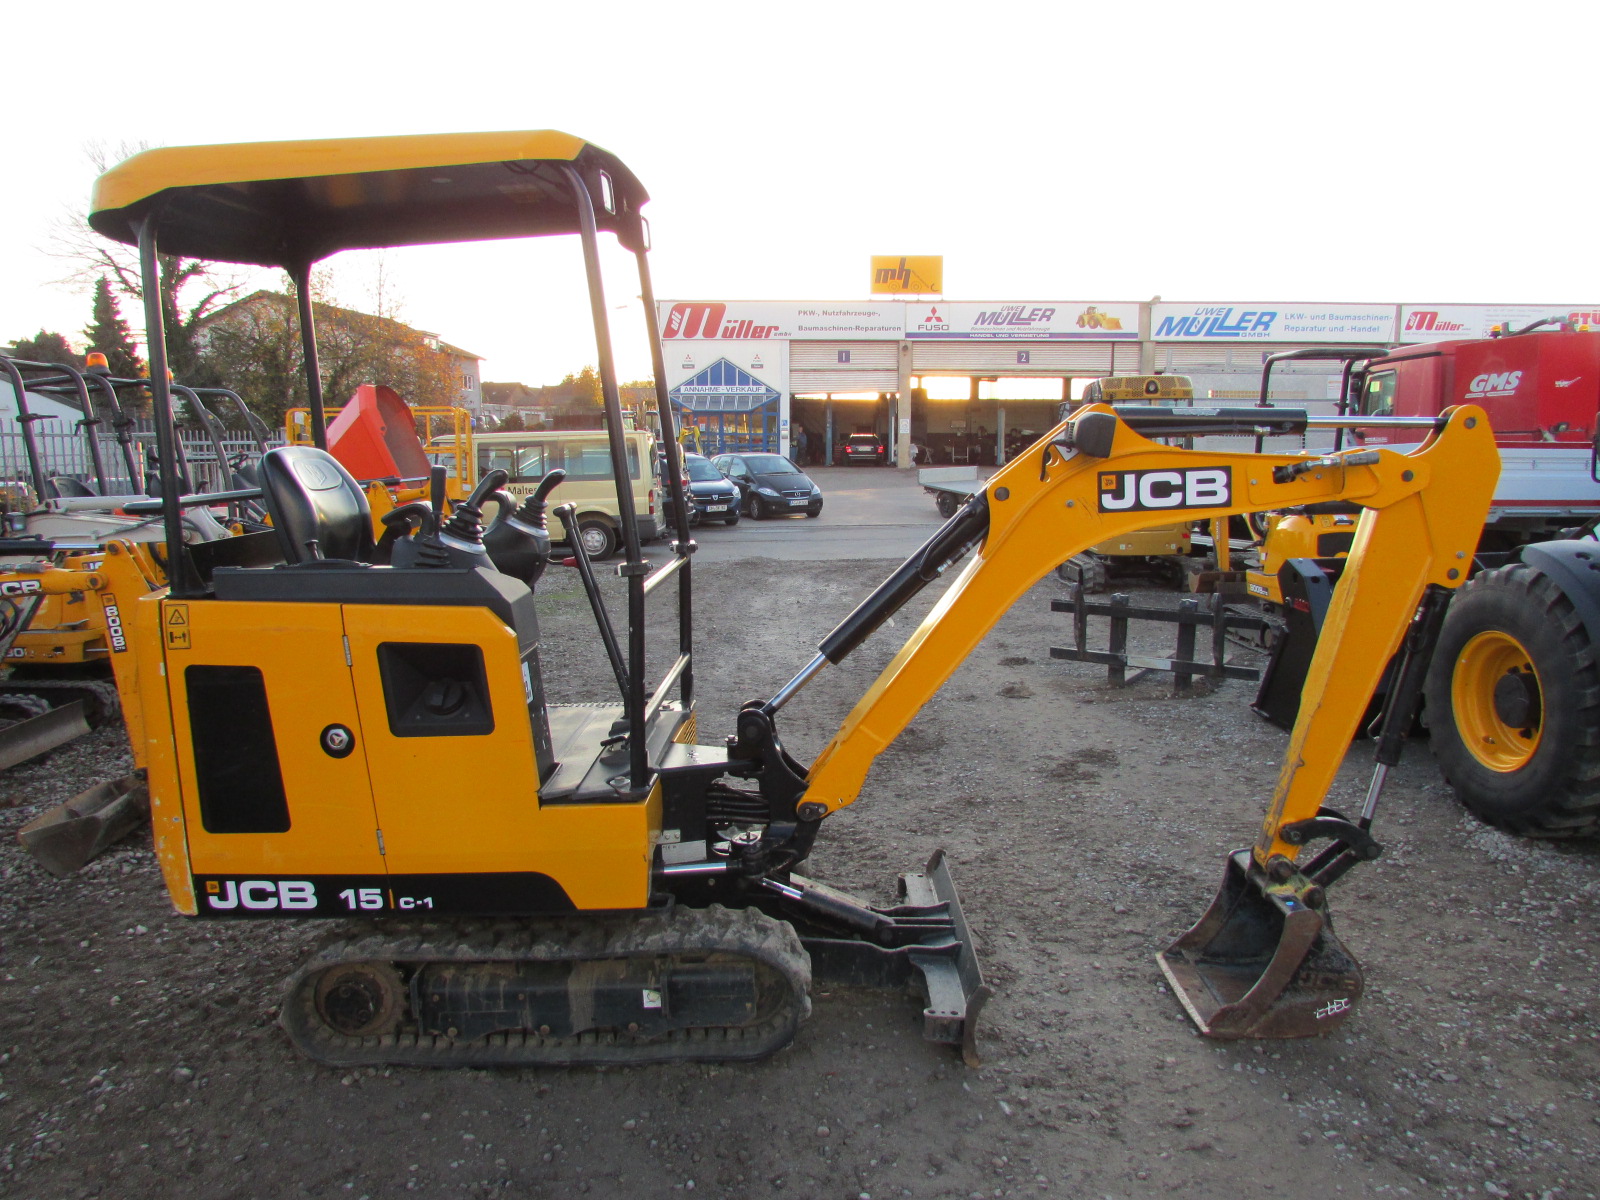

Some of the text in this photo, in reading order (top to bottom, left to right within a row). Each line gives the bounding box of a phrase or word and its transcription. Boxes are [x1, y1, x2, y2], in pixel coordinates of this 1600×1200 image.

[875, 257, 911, 289] mh
[662, 303, 780, 338] Müller
[798, 309, 820, 317] PKW-,
[973, 306, 1056, 326] MÜLLER
[1194, 307, 1226, 316] UWE
[1404, 311, 1464, 331] Müller
[1154, 307, 1278, 337] MÜLLER
[1284, 325, 1326, 333] Reparatur
[1020, 353, 1027, 362] 2
[1470, 371, 1522, 392] GMS
[1101, 470, 1229, 510] JCB
[208, 880, 318, 910] JCB
[339, 888, 384, 909] 15
